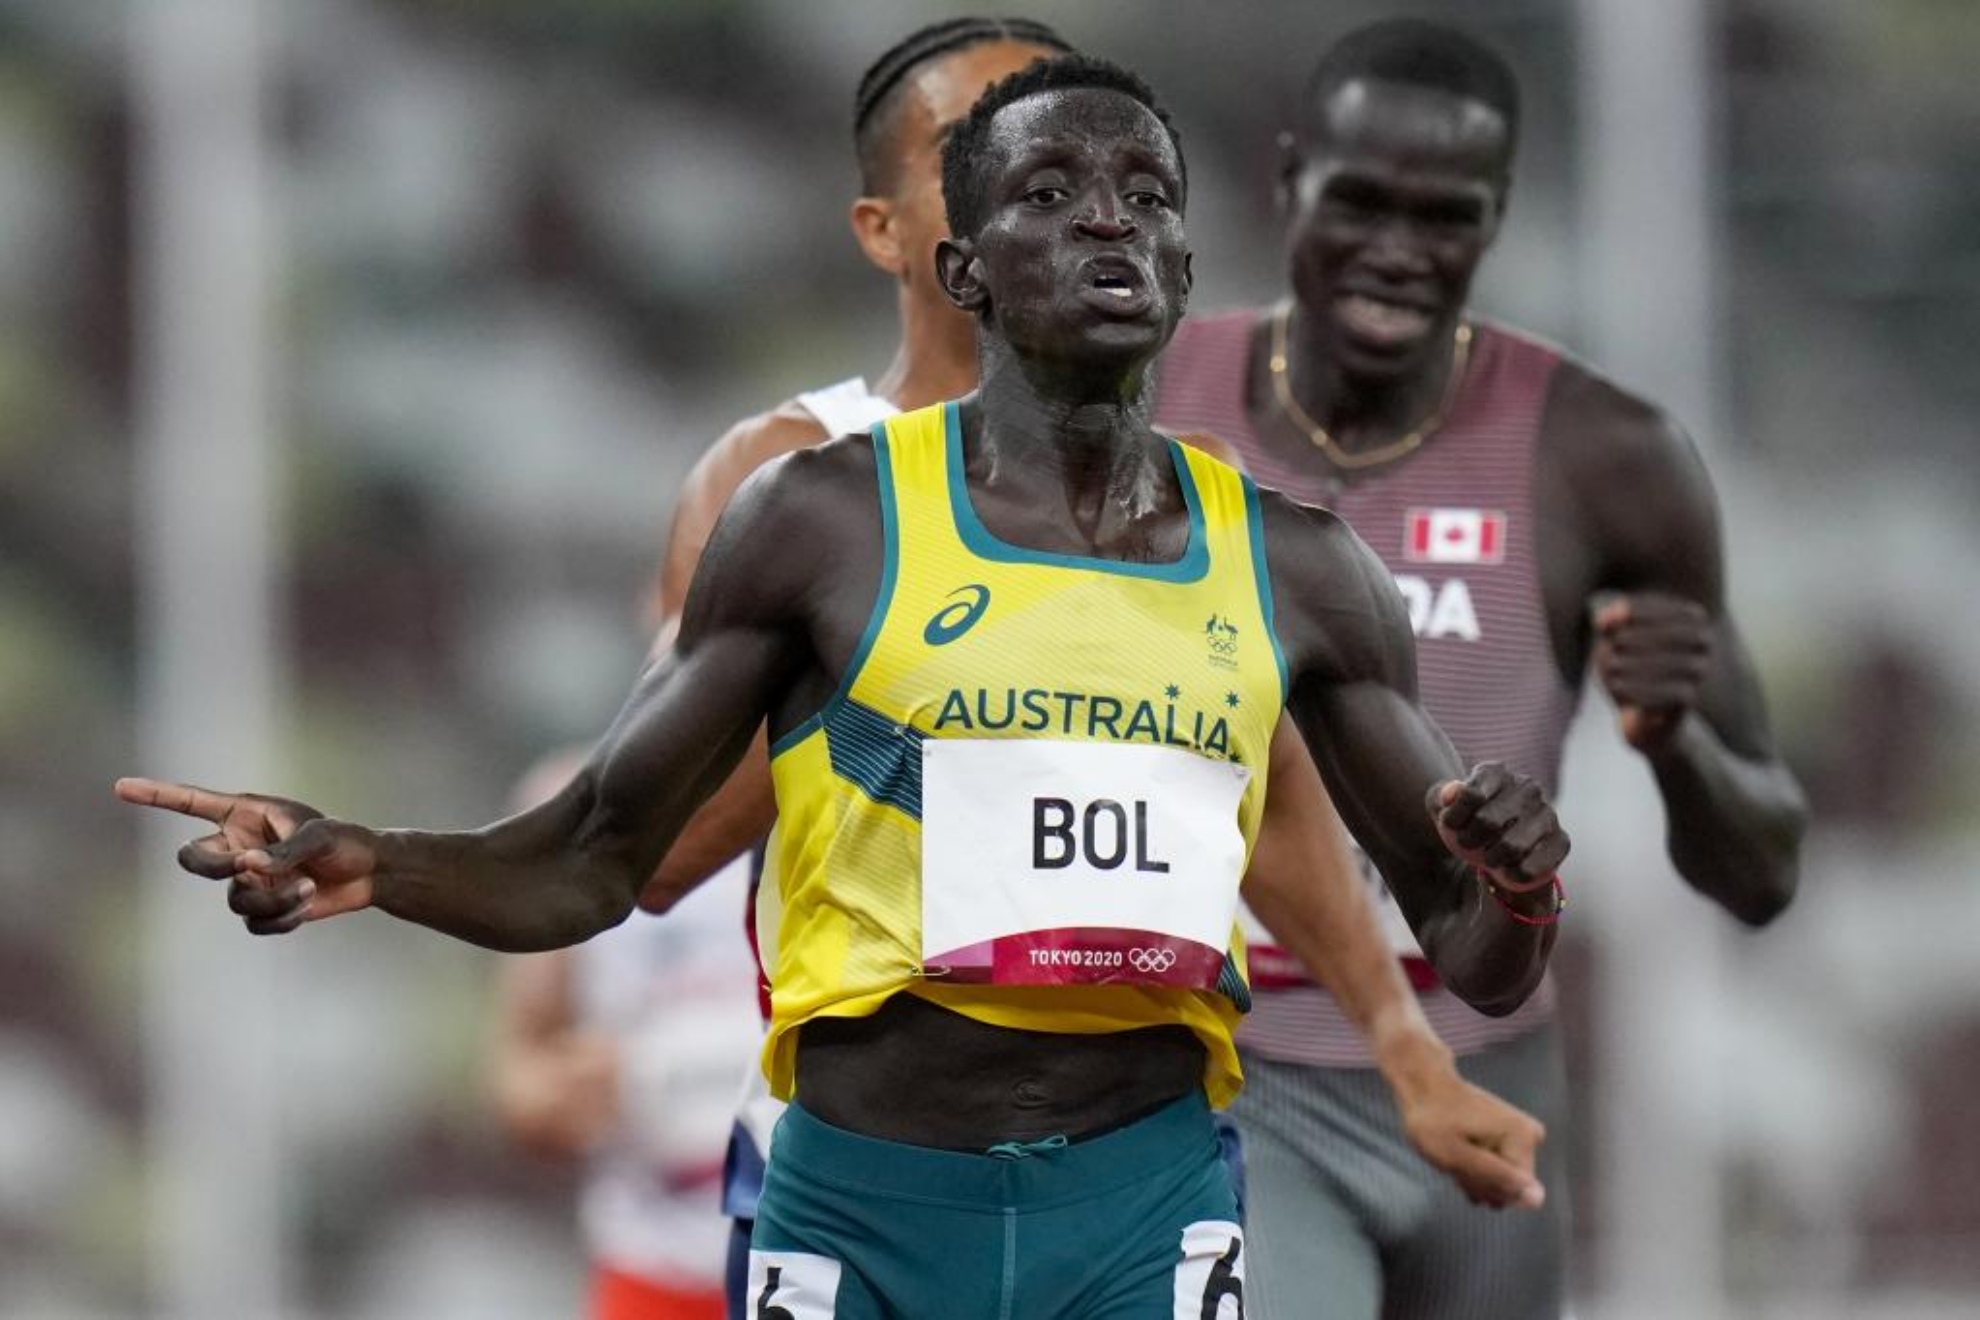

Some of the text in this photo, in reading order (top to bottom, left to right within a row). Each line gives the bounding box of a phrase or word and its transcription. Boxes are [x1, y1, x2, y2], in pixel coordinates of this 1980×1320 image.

[934, 688, 1229, 755] AUSTRALIA
[1033, 797, 1170, 873] BOL
[1029, 950, 1122, 966] TOKYO 2020
